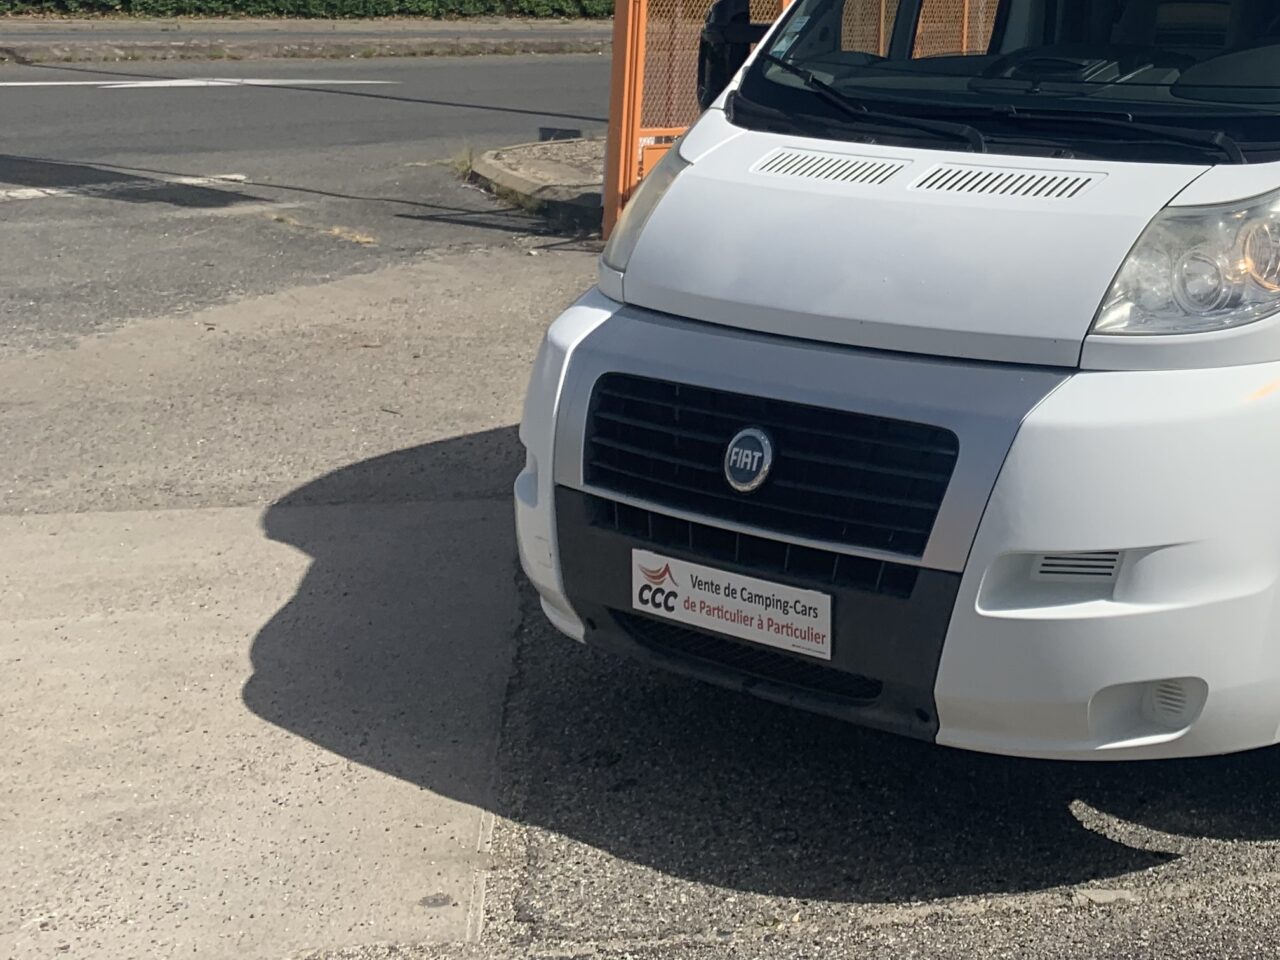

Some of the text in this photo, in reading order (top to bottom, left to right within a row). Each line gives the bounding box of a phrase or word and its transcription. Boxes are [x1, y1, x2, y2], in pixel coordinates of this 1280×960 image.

[729, 447, 763, 472] FIAT
[638, 584, 678, 613] CCC
[690, 573, 819, 619] Vente de Camping-Cars
[683, 596, 826, 646] de Particulier à Particulier
